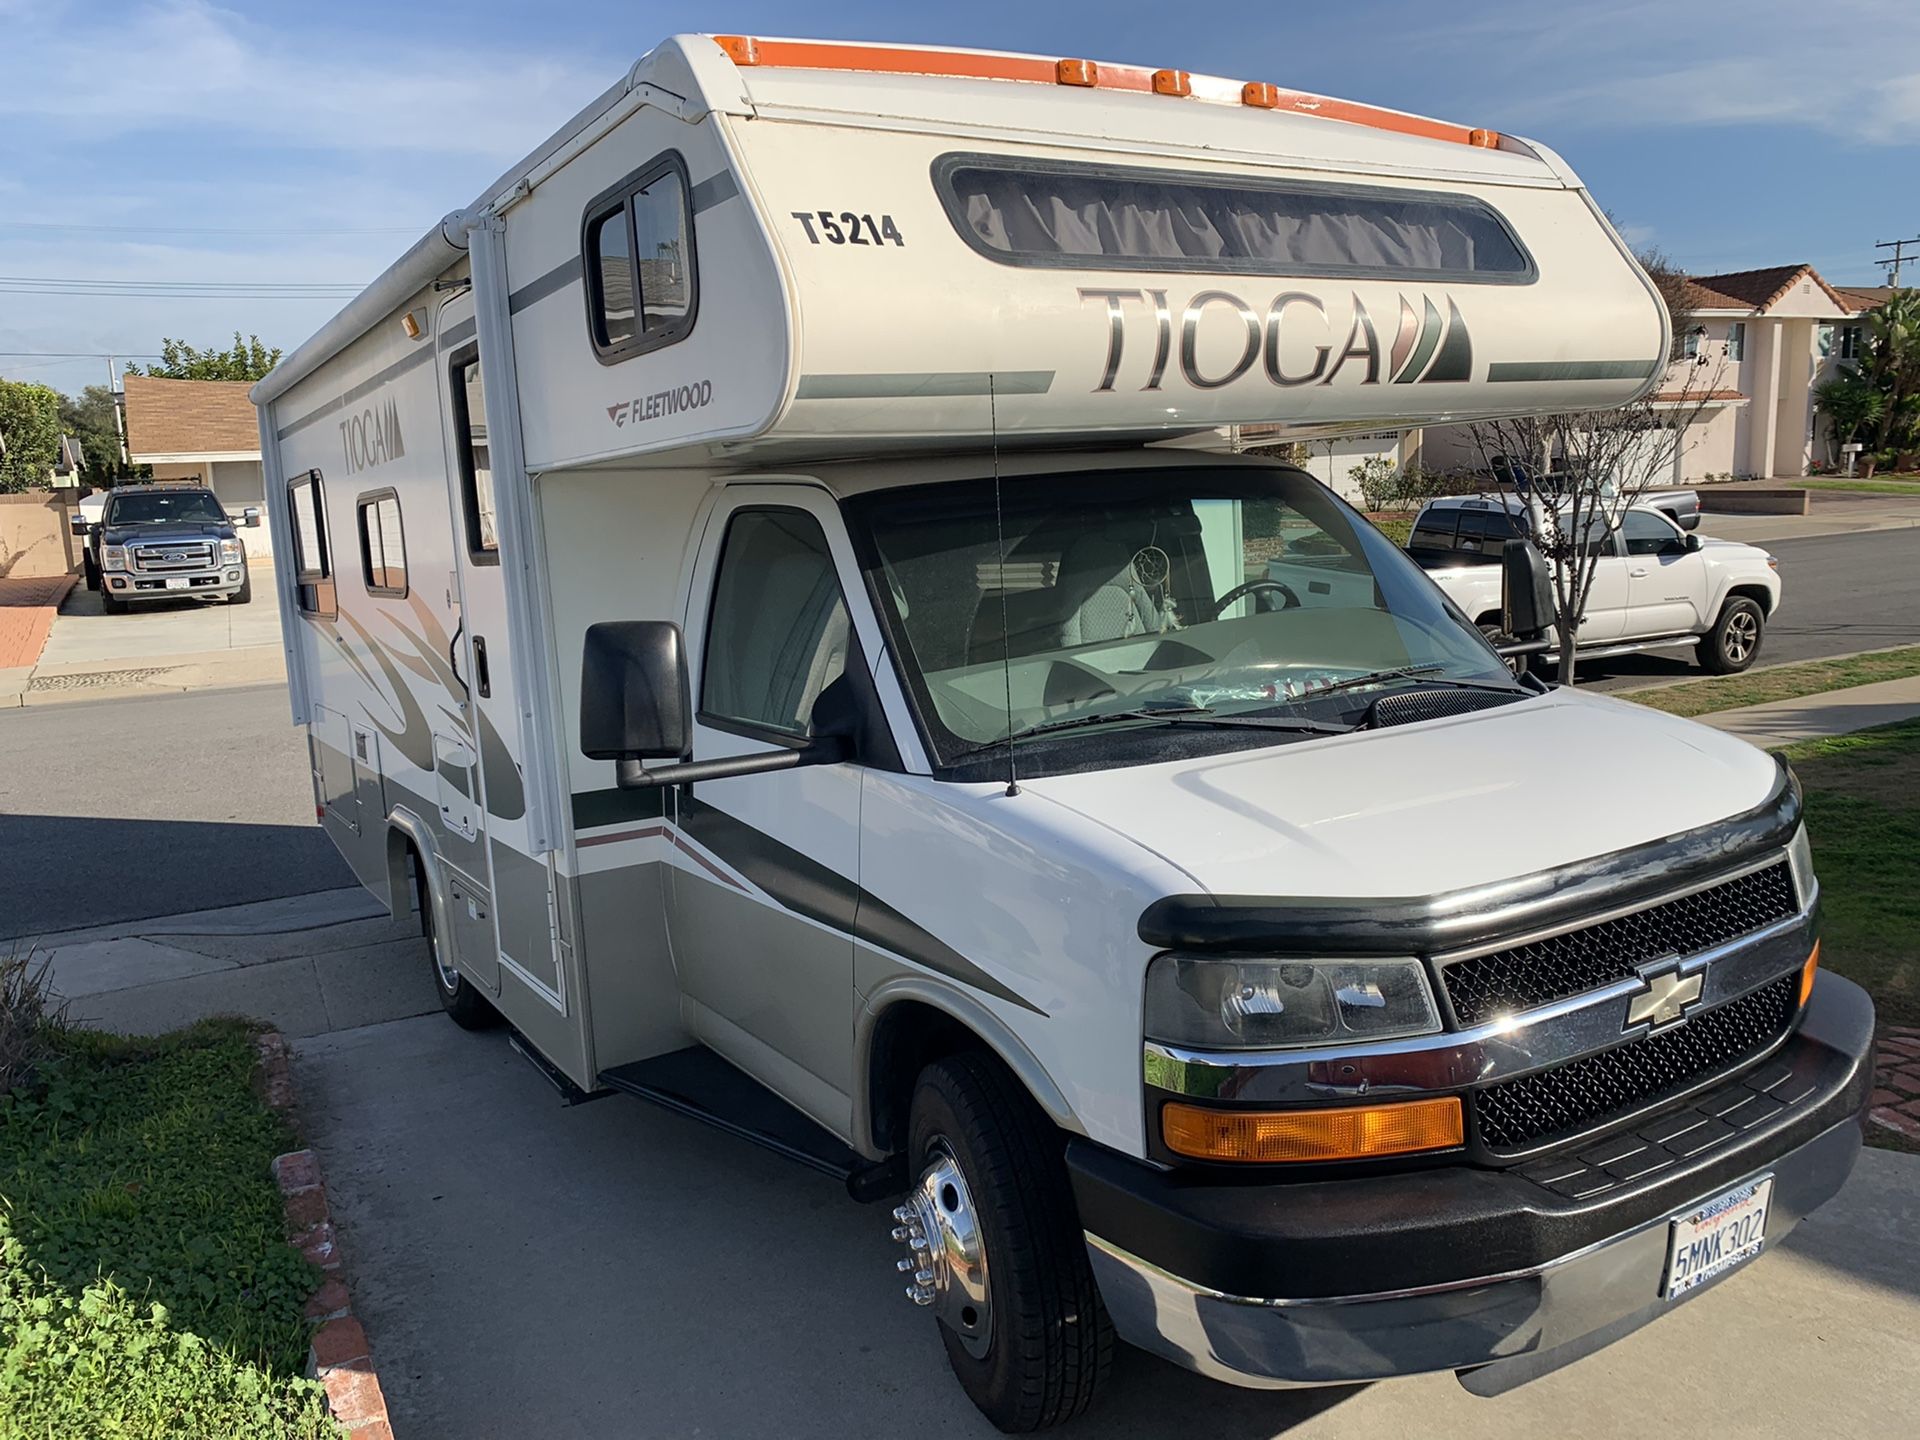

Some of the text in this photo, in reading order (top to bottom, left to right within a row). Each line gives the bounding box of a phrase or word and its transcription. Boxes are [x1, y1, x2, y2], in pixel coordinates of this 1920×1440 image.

[791, 211, 904, 247] T5214
[1077, 287, 1380, 392] TIOGA
[632, 380, 711, 423] FLEETWOOD
[339, 404, 387, 475] TIOGA
